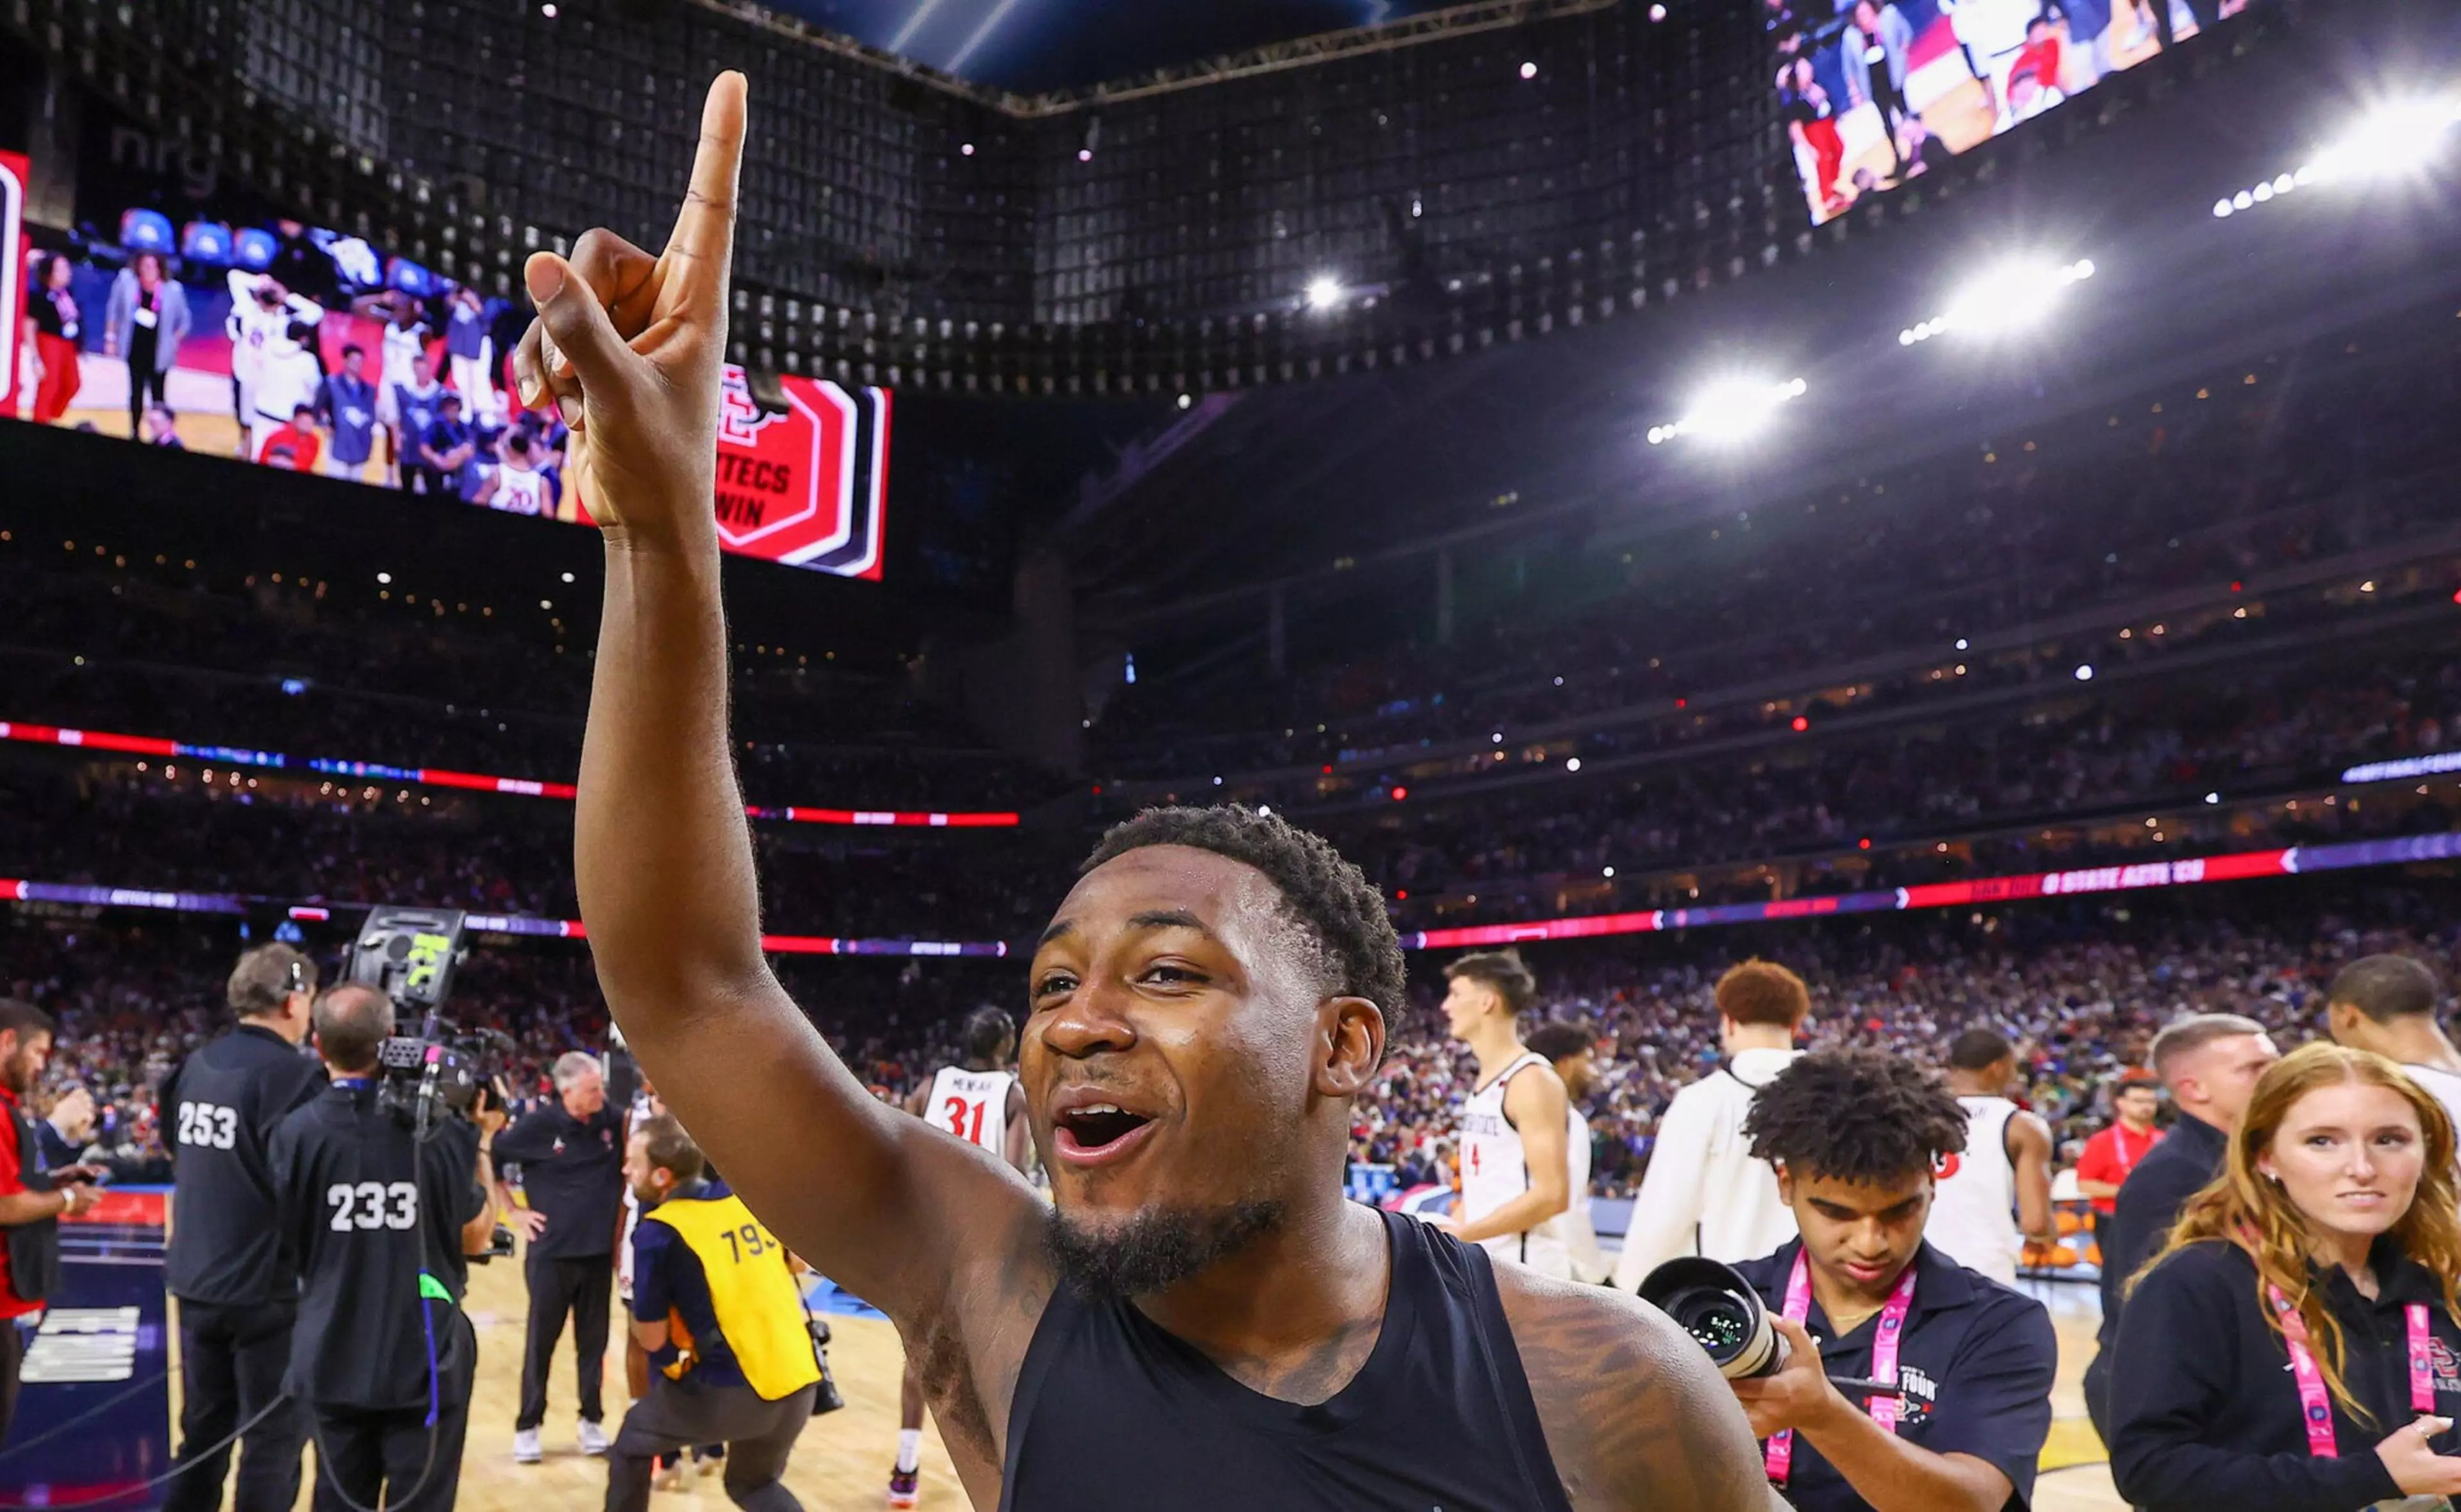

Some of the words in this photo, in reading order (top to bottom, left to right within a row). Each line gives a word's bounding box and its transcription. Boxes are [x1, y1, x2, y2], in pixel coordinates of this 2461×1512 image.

[716, 451, 790, 495] TECS
[179, 1101, 237, 1150] 253
[945, 1096, 986, 1146] 31
[327, 1181, 418, 1231] 233
[1902, 1372, 1936, 1402] FOUR
